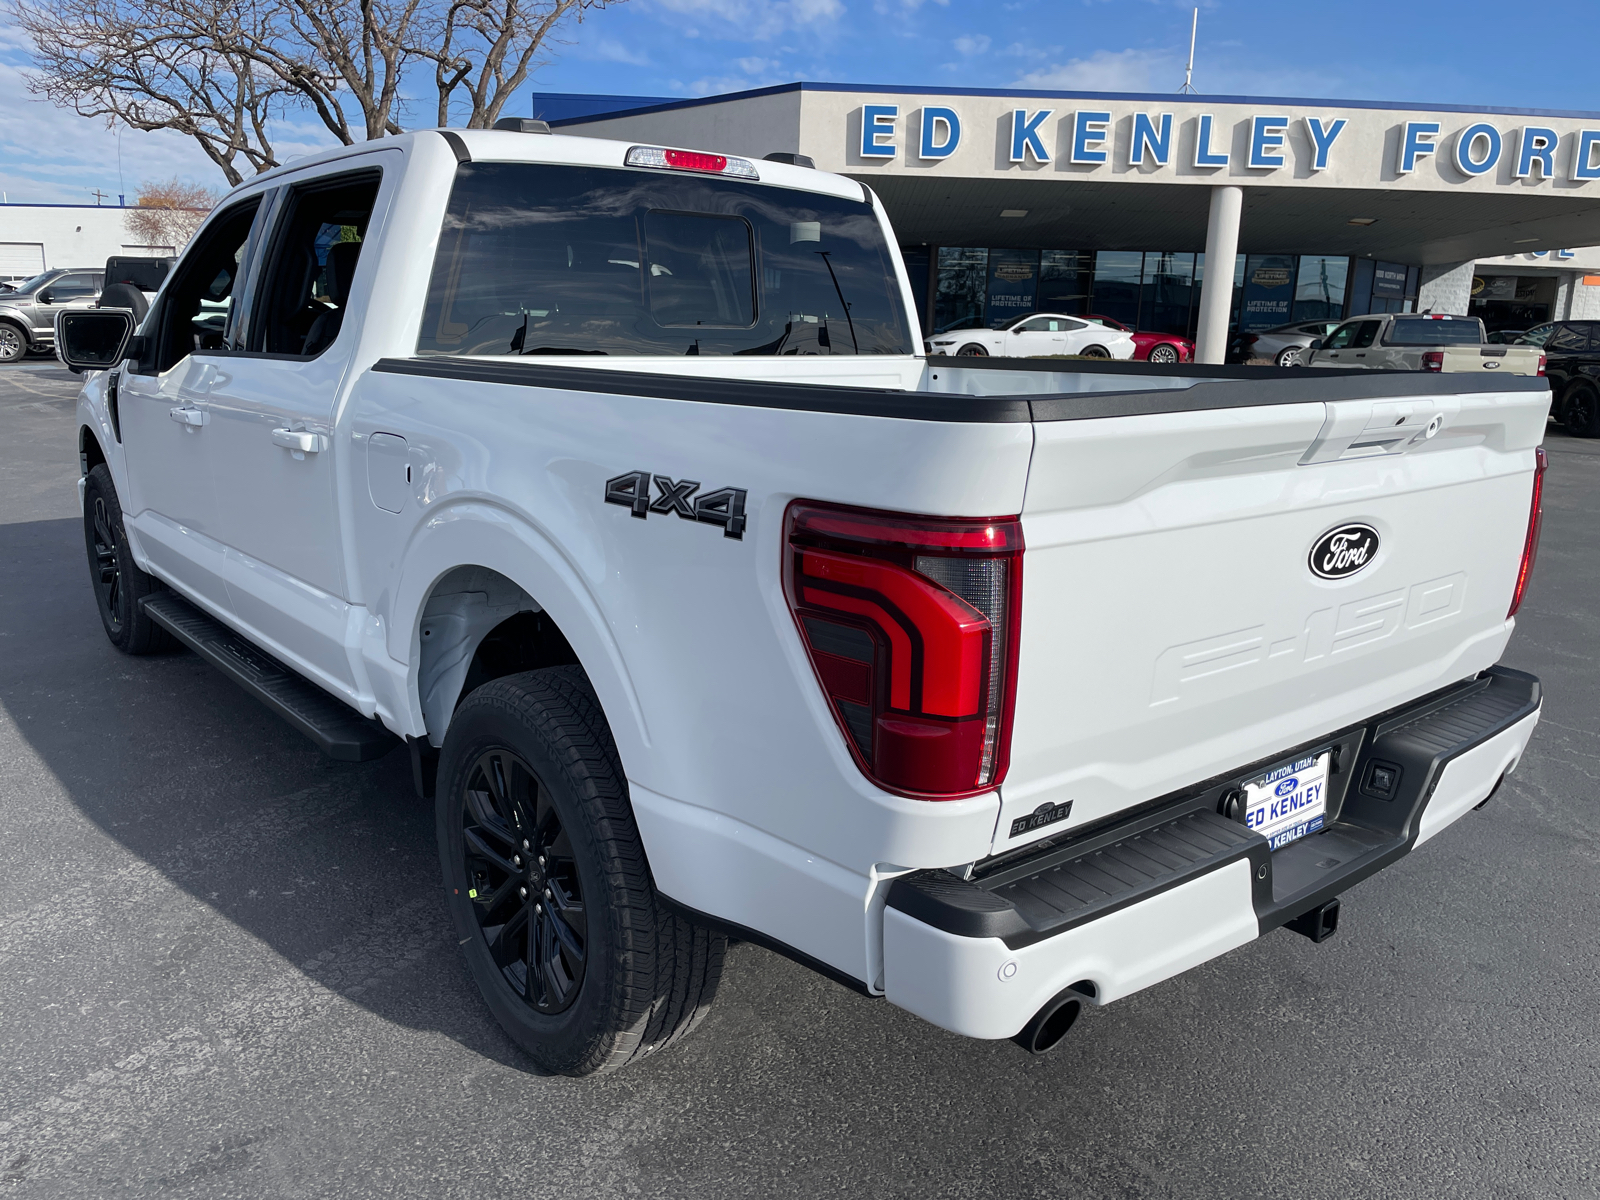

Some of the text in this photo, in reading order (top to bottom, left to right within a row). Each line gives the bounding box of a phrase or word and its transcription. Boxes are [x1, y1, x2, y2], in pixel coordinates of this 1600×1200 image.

[860, 104, 1600, 181] ED KENLEY FORD
[1323, 531, 1371, 572] Ford
[1149, 570, 1468, 708] F-150
[1294, 756, 1313, 771] UTAH
[1246, 807, 1265, 829] ED
[1269, 782, 1322, 821] KENLEY
[1278, 780, 1295, 796] Ford
[1011, 823, 1026, 834] ED
[1029, 805, 1072, 828] KENLEY
[1273, 822, 1309, 849] KENLEY
